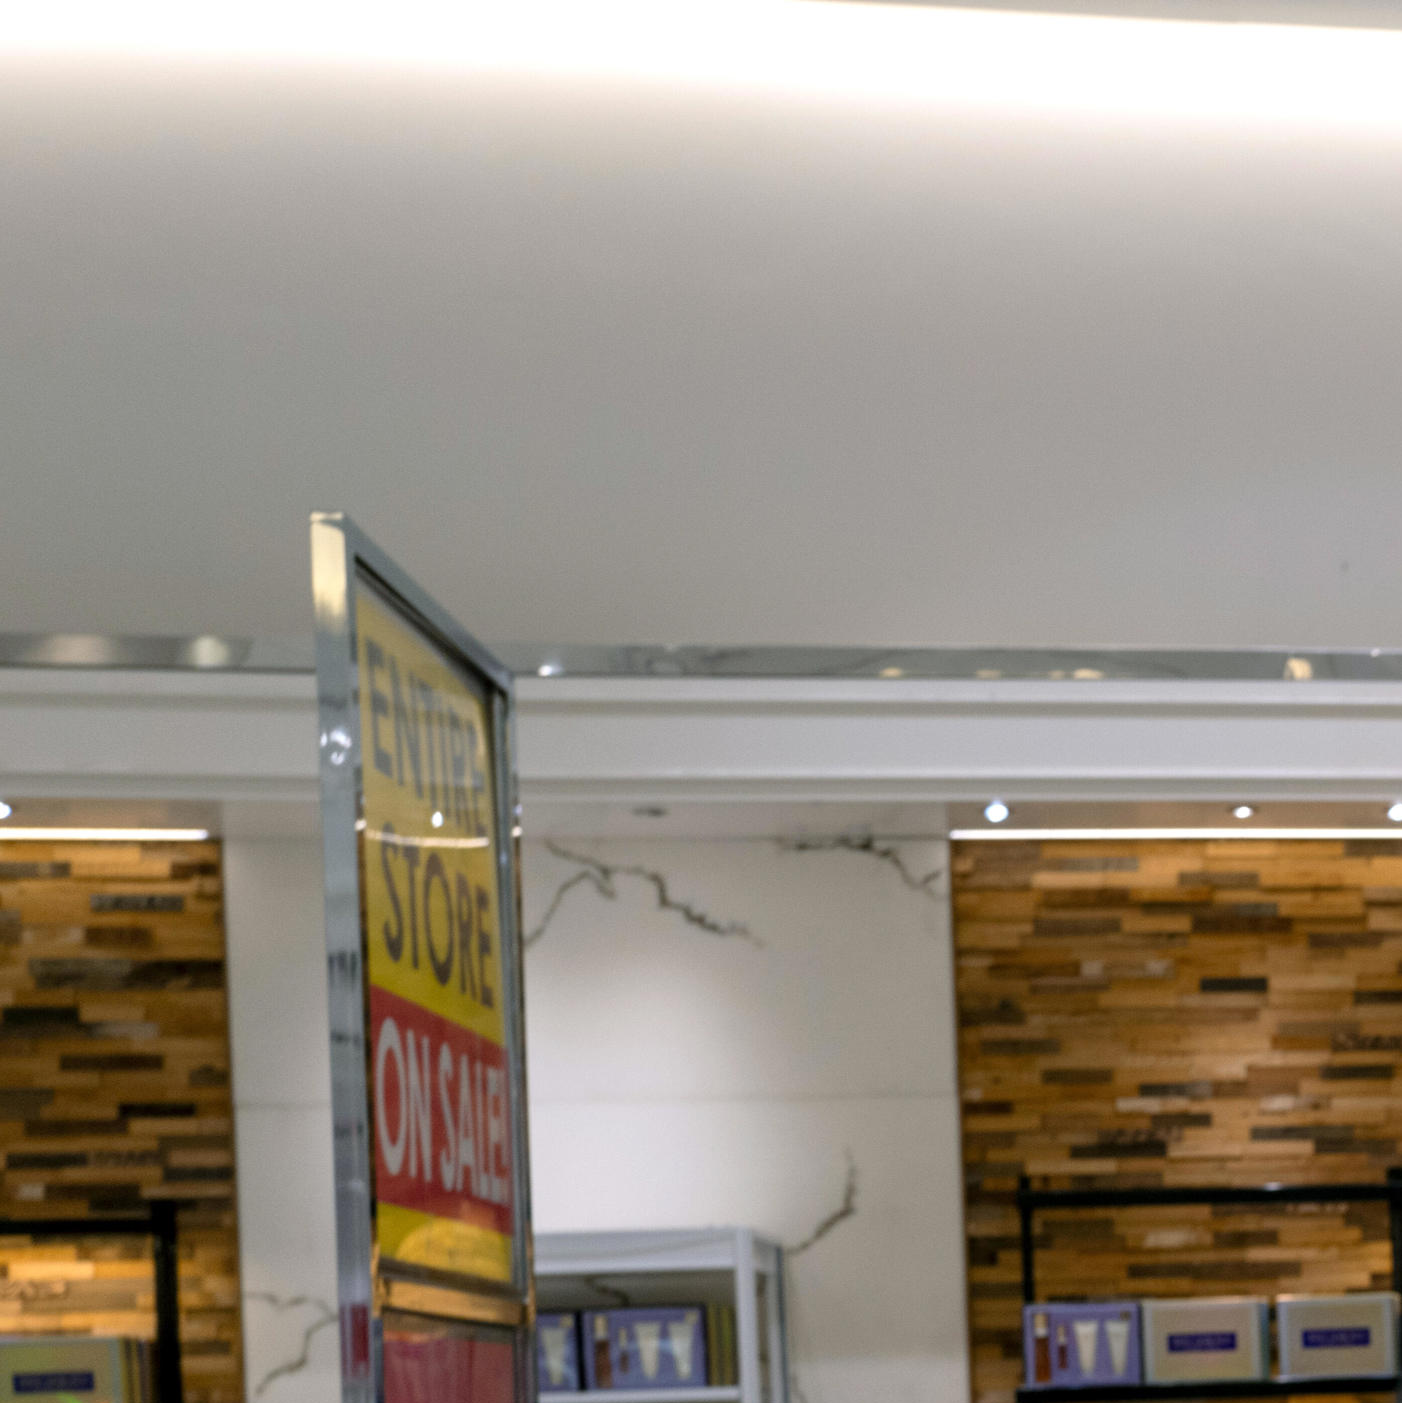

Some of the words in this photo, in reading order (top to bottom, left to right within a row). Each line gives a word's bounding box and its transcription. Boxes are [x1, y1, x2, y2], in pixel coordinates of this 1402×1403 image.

[366, 636, 486, 834] ENTIRE
[380, 825, 495, 1009] STORE
[375, 1017, 433, 1184] ON
[439, 1042, 510, 1201] SALE!
